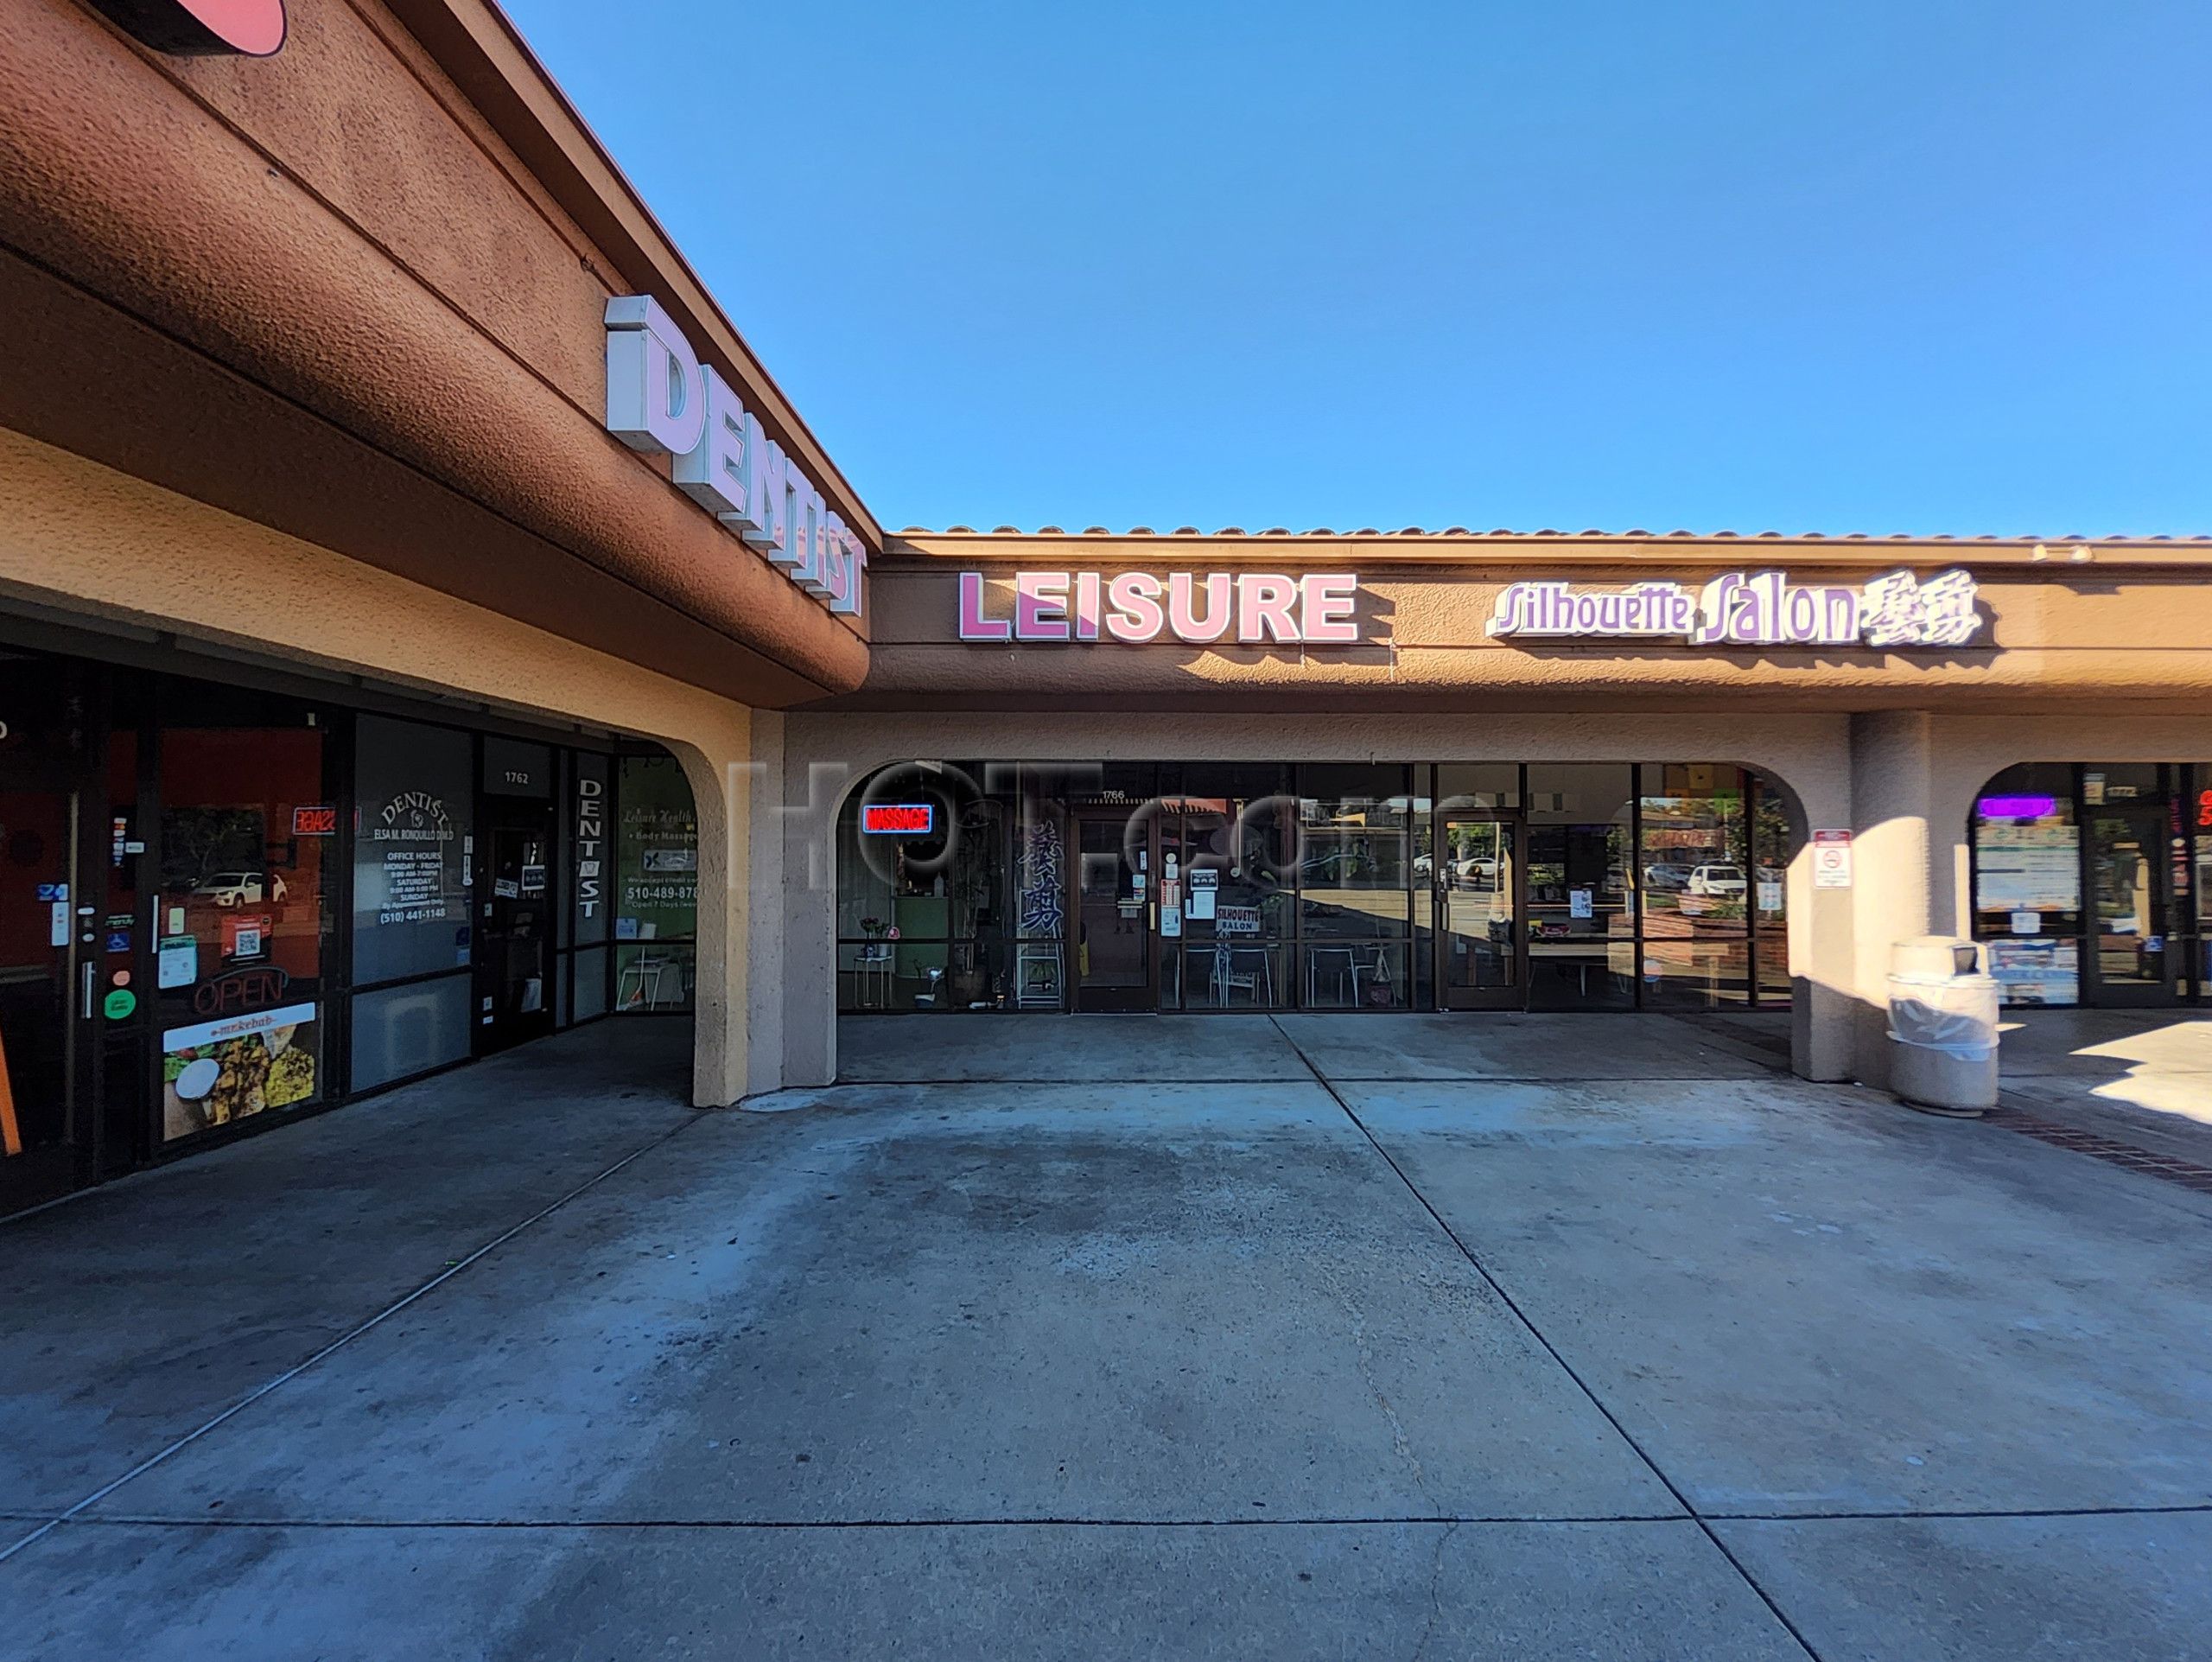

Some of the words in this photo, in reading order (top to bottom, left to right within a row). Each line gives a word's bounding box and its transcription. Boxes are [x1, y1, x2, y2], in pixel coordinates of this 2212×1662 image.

[605, 295, 868, 618] DENTIST
[959, 572, 1357, 644] LEISURE
[1486, 581, 1694, 636] Silhouette
[1695, 571, 1860, 645] Salon
[505, 771, 529, 785] 1762
[1103, 790, 1125, 800] 1766
[381, 792, 448, 826] DENTIST
[866, 808, 929, 831] MASSAGE
[387, 852, 414, 861] OFFICE
[416, 851, 442, 861] HOURS
[400, 893, 429, 901] SUNDAY
[627, 887, 697, 900] 510-489-878
[380, 912, 404, 924] (510)
[406, 908, 446, 920] 441-1148
[1217, 908, 1259, 922] SILHOUETTE
[194, 973, 283, 1015] OPEN
